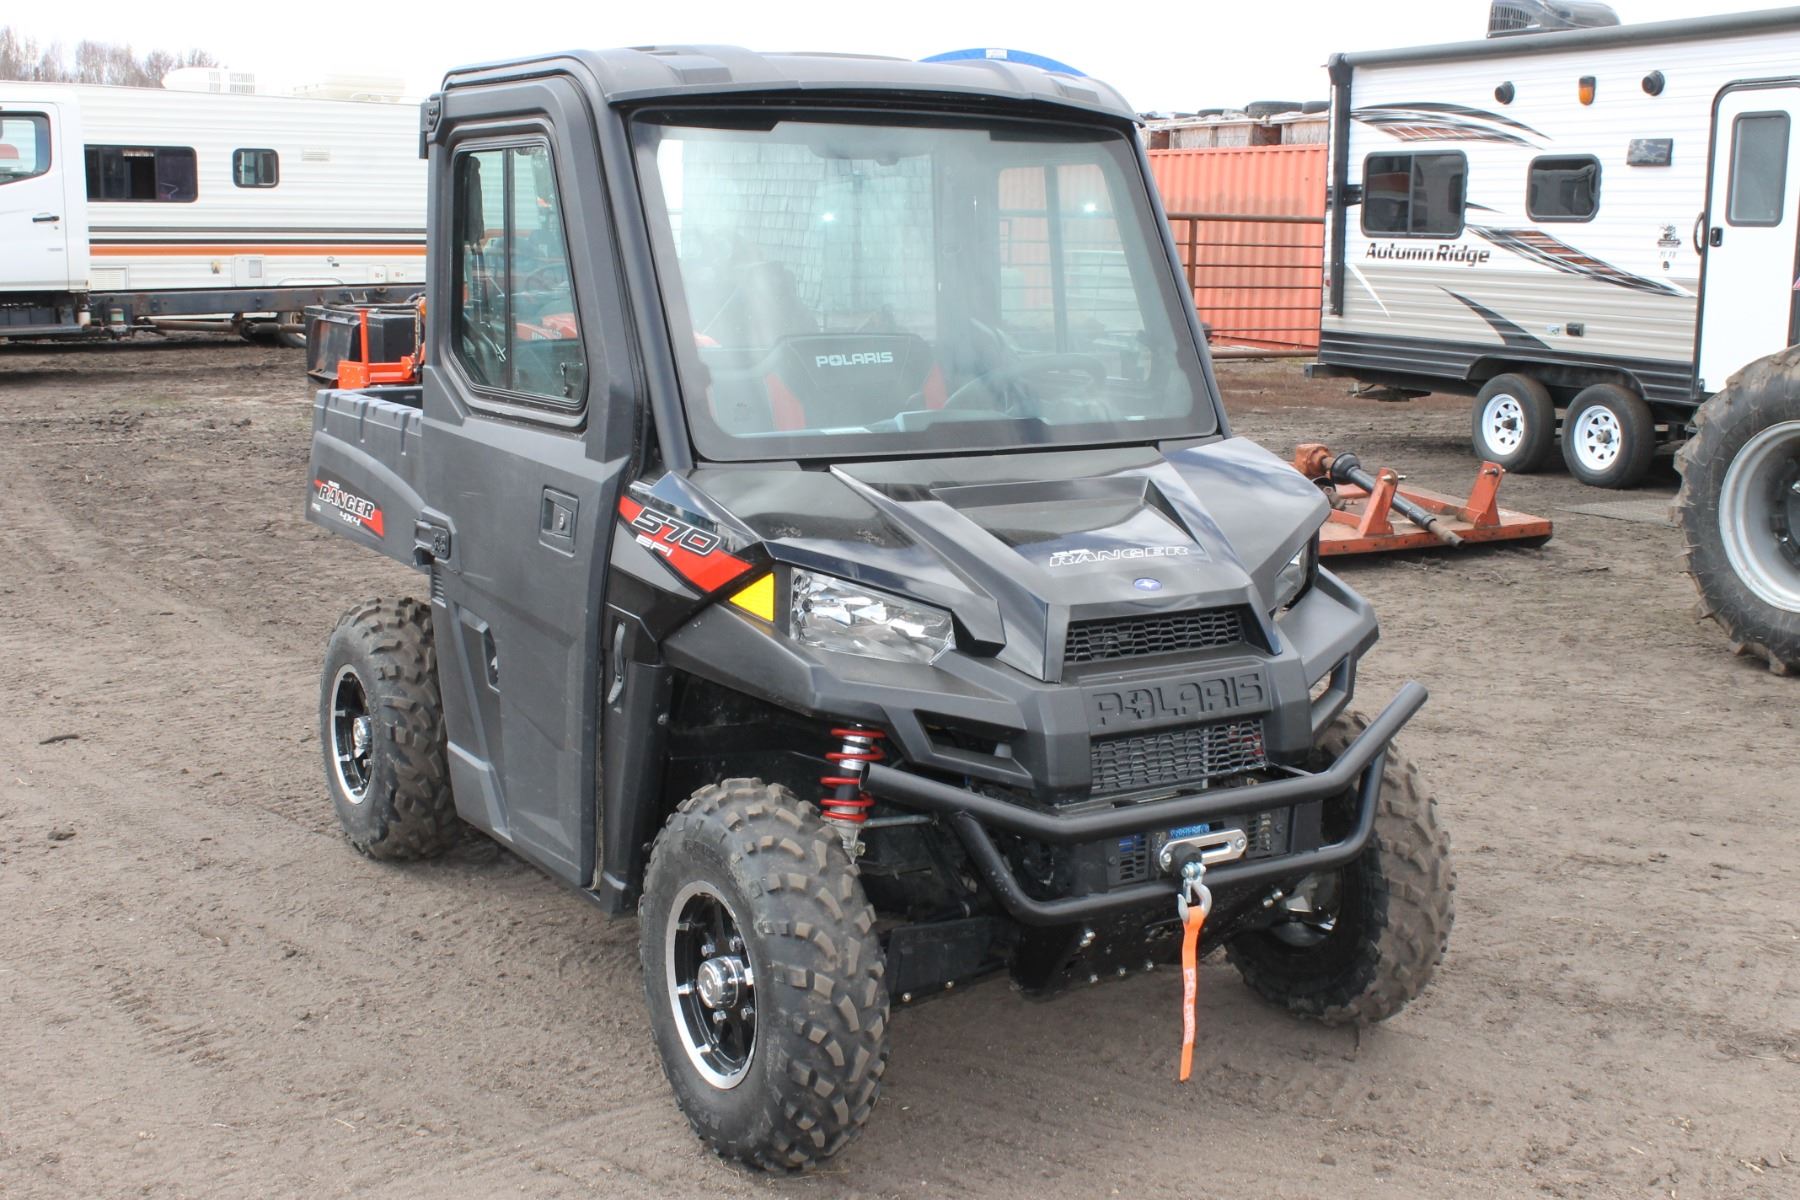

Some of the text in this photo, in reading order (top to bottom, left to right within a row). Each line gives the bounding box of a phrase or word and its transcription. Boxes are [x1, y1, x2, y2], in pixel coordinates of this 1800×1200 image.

[1365, 242, 1490, 267] Autumn Ridge
[815, 351, 894, 368] POLARIS
[318, 483, 376, 521] RANGER
[631, 506, 721, 556] 570
[635, 533, 673, 557] EFI
[1049, 546, 1190, 568] RANGER
[1092, 673, 1264, 726] POLARIS
[1183, 968, 1197, 1045] POLARIS
